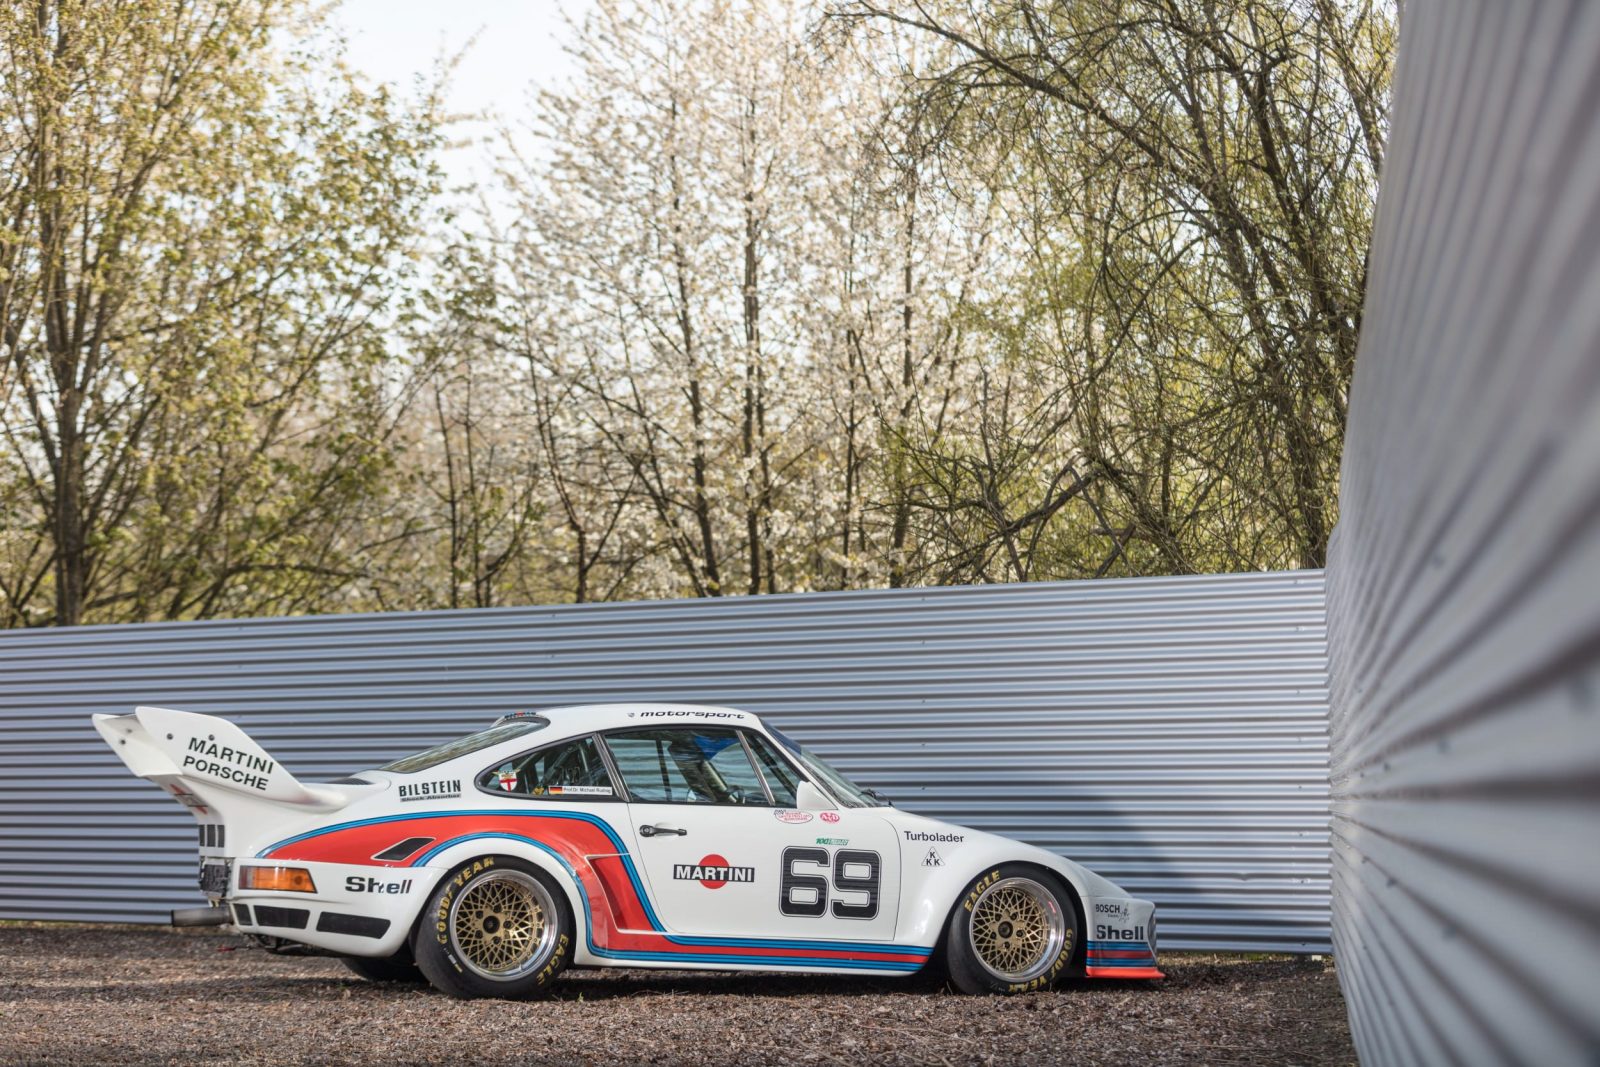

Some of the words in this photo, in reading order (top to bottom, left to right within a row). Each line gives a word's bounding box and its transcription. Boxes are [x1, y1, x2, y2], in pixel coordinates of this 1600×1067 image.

[640, 710, 744, 719] motorsport
[188, 737, 274, 774] MARTINI
[183, 755, 269, 791] PORSCHE
[399, 780, 461, 797] BILSTEIN
[904, 831, 964, 842] Turbolader
[676, 865, 753, 882] MARTINI
[345, 876, 412, 894] Shell
[778, 846, 882, 920] 69
[964, 870, 1000, 912] EAGLE
[1096, 904, 1120, 914] BOSCH
[1096, 924, 1144, 940] Shell
[536, 934, 569, 986] EAGLE
